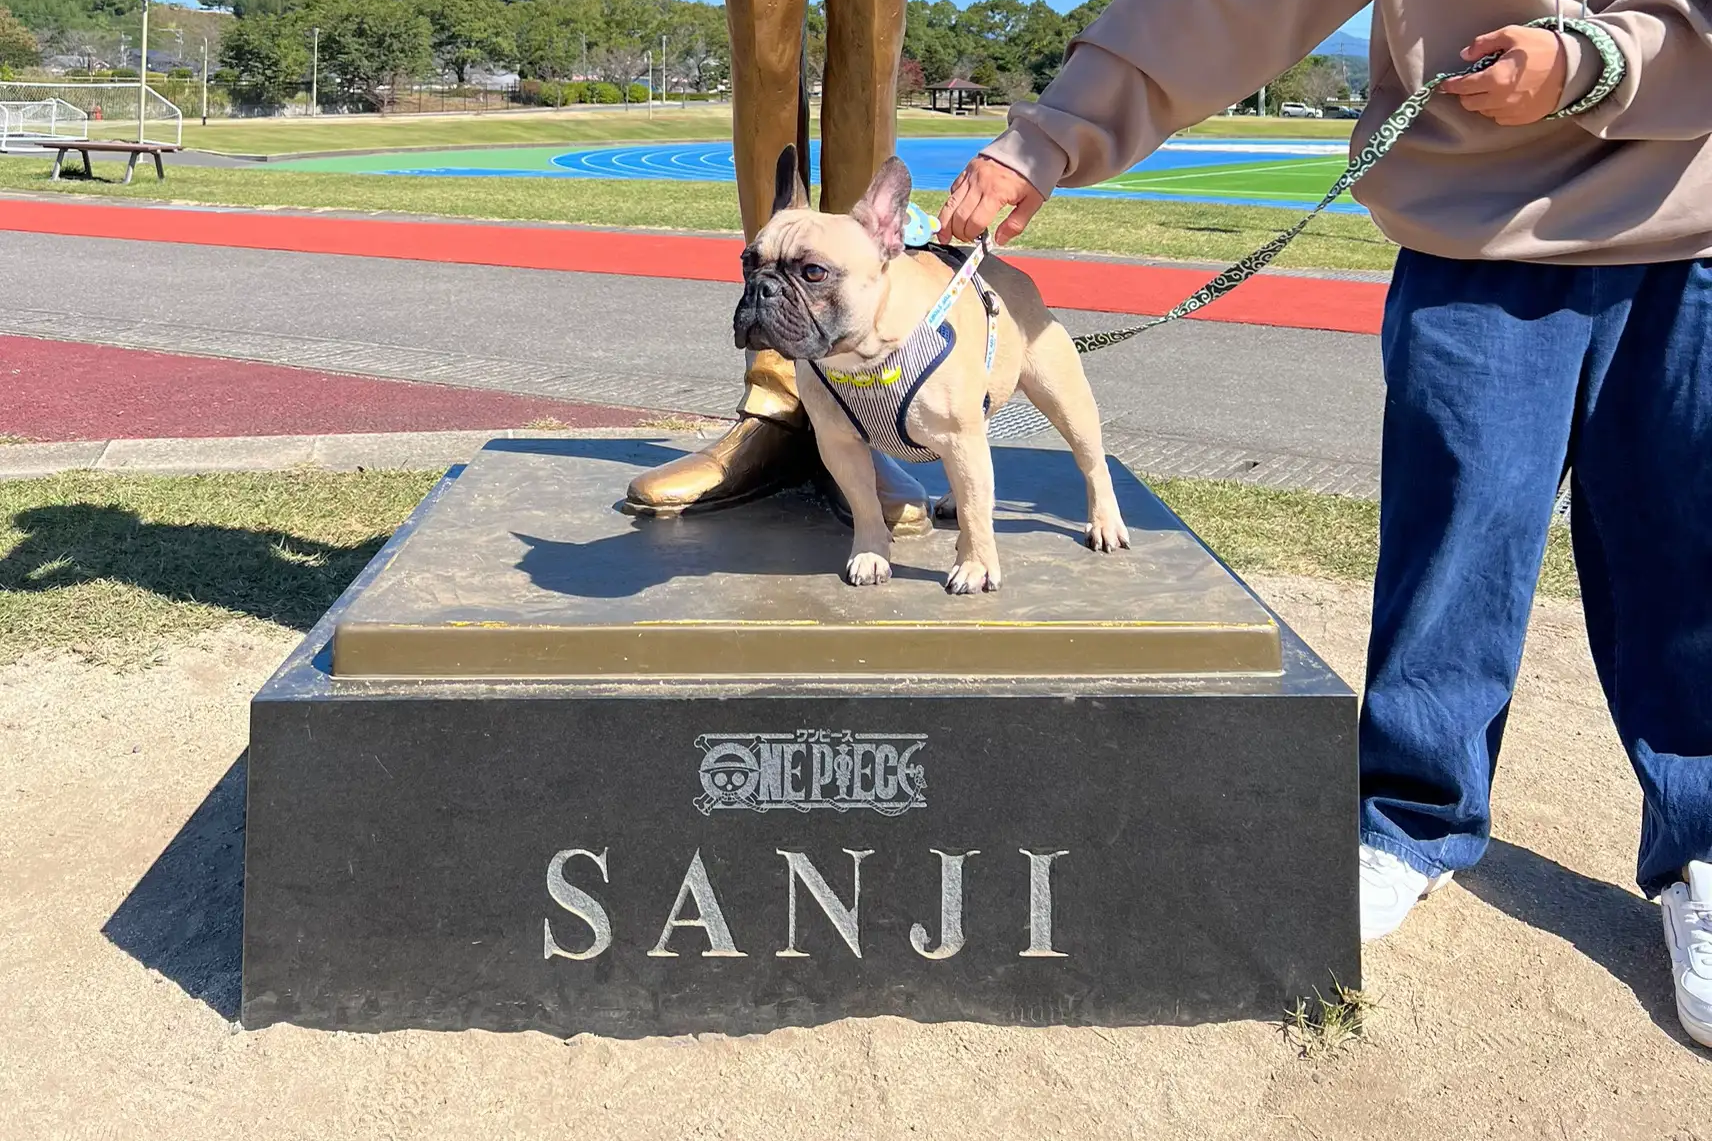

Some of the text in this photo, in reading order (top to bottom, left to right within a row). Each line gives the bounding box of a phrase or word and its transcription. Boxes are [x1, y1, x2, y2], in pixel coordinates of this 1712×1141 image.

[796, 728, 853, 742] ワンピース
[807, 742, 927, 801] PIECE
[544, 846, 1069, 960] SANJI
